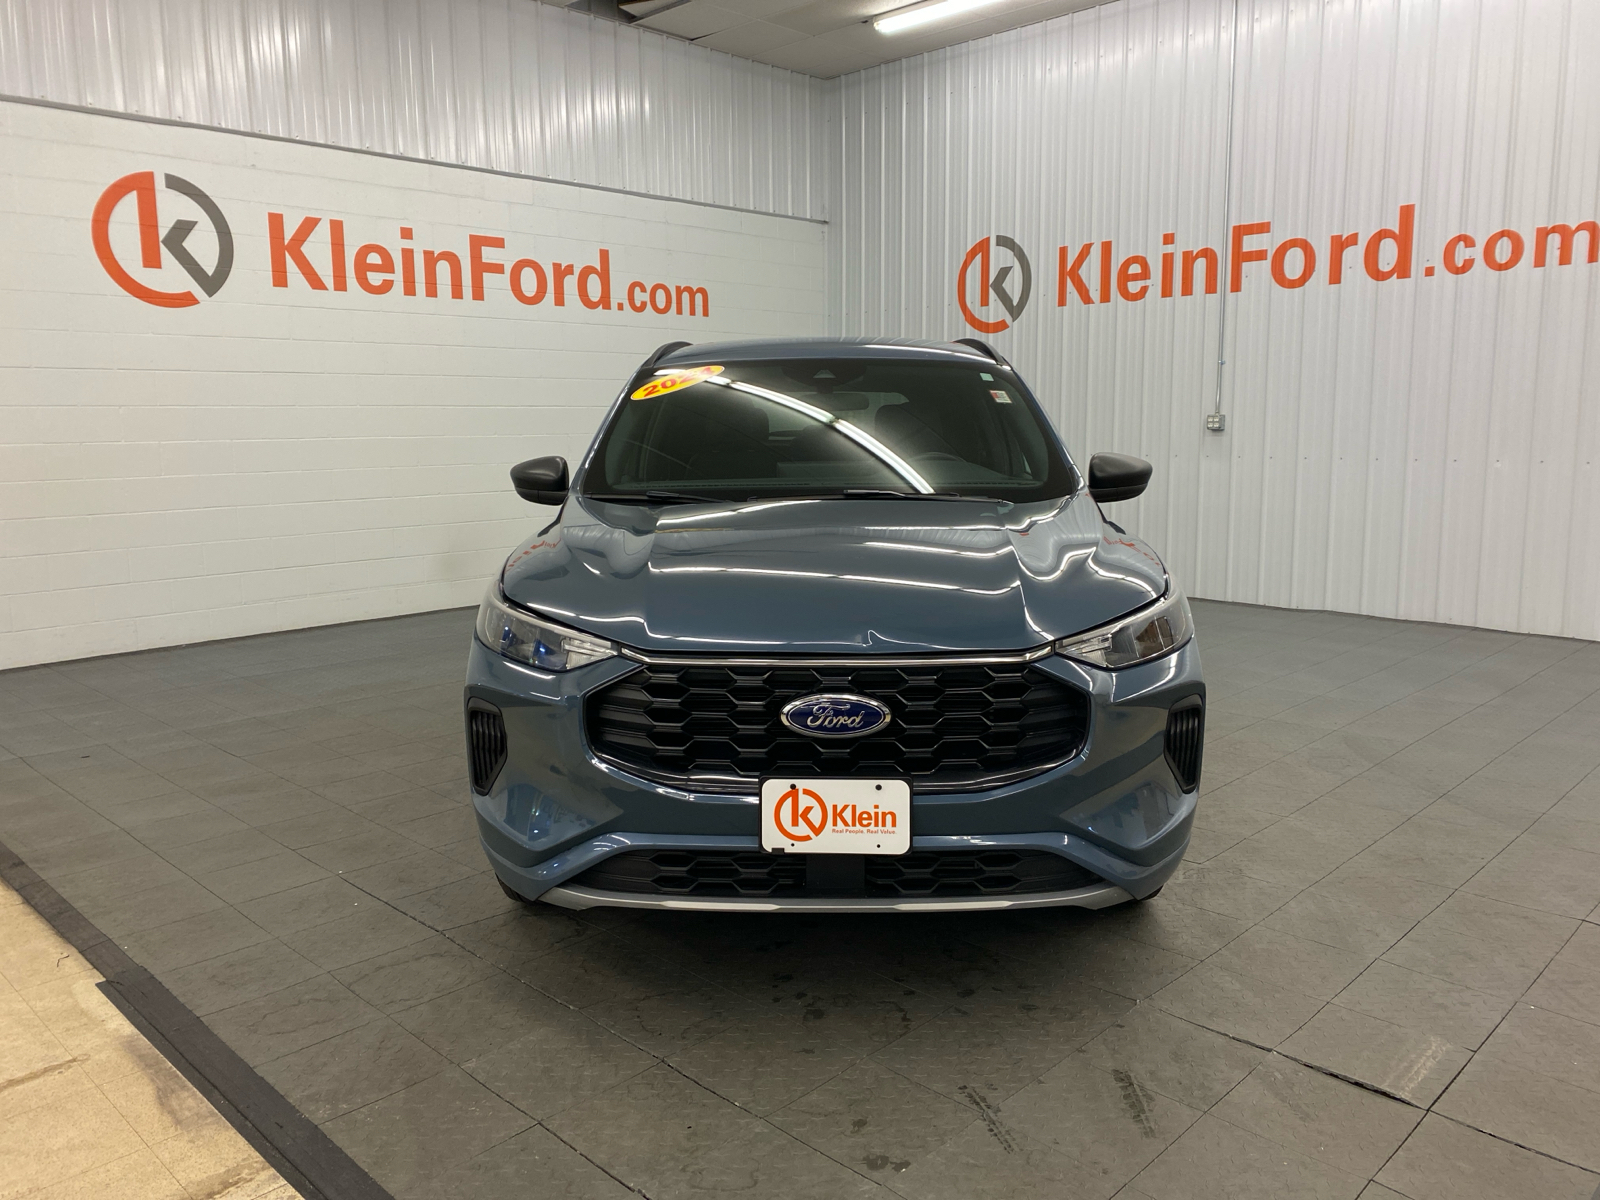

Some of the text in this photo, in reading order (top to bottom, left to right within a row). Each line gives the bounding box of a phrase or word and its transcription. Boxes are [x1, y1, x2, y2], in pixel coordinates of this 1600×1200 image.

[267, 211, 711, 318] KleinFord.com
[1057, 203, 1600, 308] KleinFord.com
[801, 701, 865, 728] Ford
[832, 804, 897, 828] Klein
